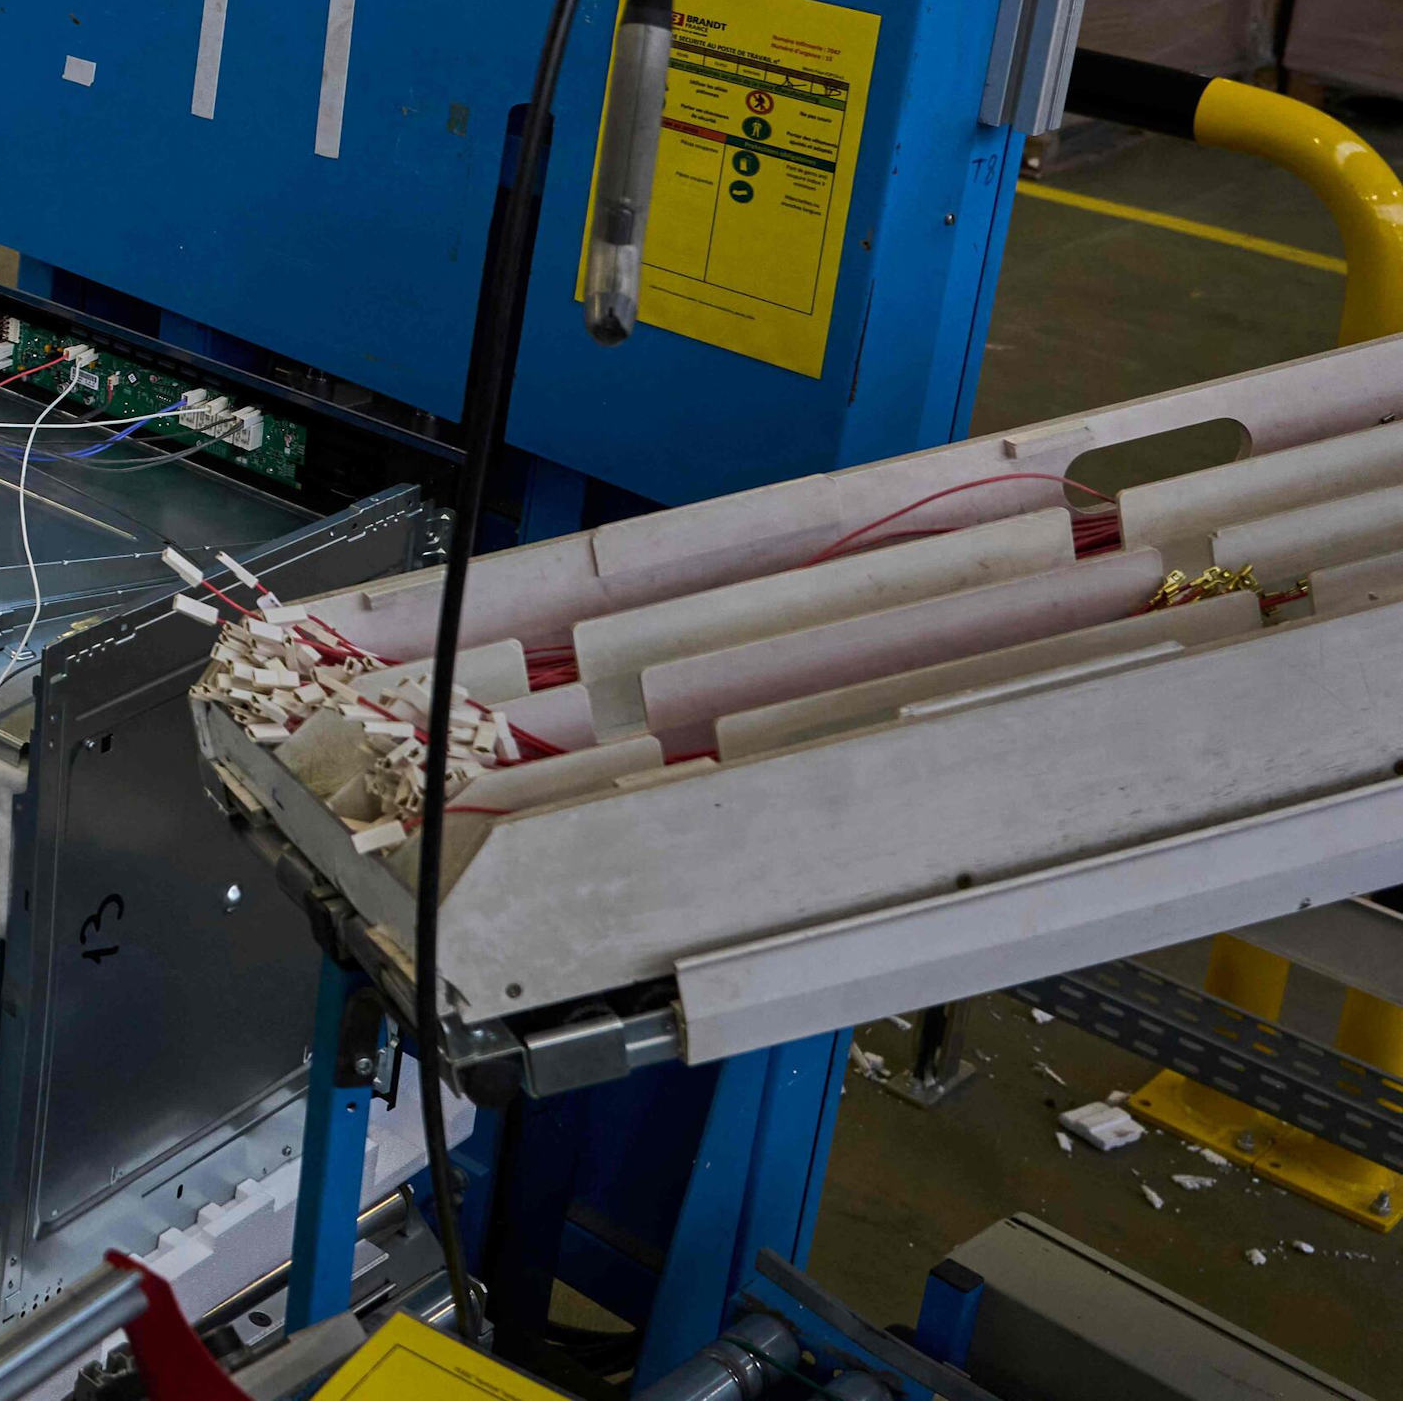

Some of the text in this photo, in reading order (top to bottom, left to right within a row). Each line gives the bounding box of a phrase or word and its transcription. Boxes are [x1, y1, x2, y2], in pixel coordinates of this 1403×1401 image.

[685, 14, 727, 32] BRANDT
[685, 22, 709, 33] FRANCE
[717, 43, 737, 54] POSTE
[79, 892, 124, 965] 13
